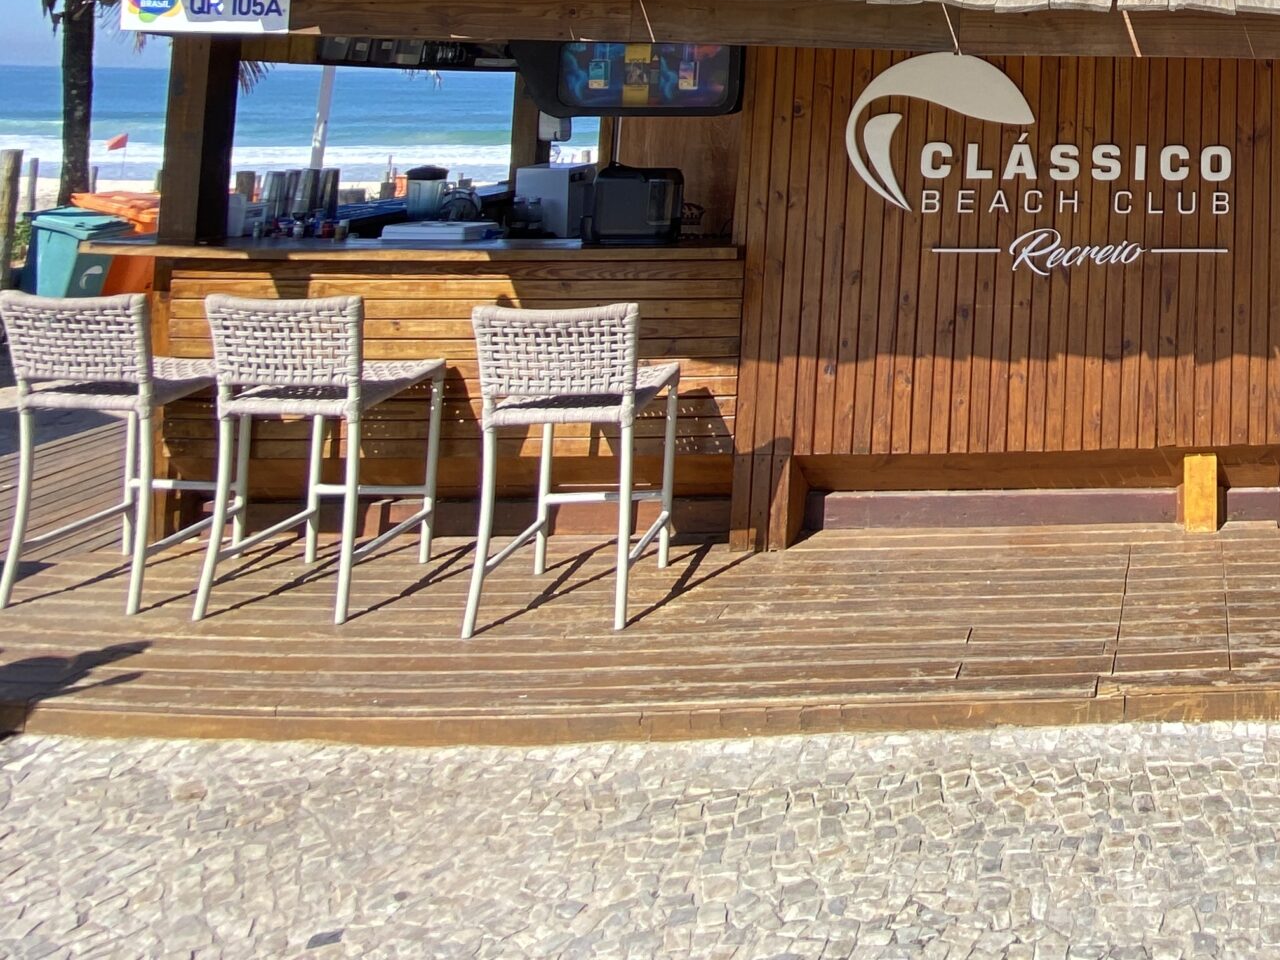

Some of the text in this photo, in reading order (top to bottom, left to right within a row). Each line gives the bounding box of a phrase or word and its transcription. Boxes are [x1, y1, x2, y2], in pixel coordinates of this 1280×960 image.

[139, 0, 171, 9] BRASIL
[920, 132, 1232, 182] CLÁSSICO
[920, 190, 1230, 215] BEACH CLUB
[1008, 228, 1148, 276] Recreio
